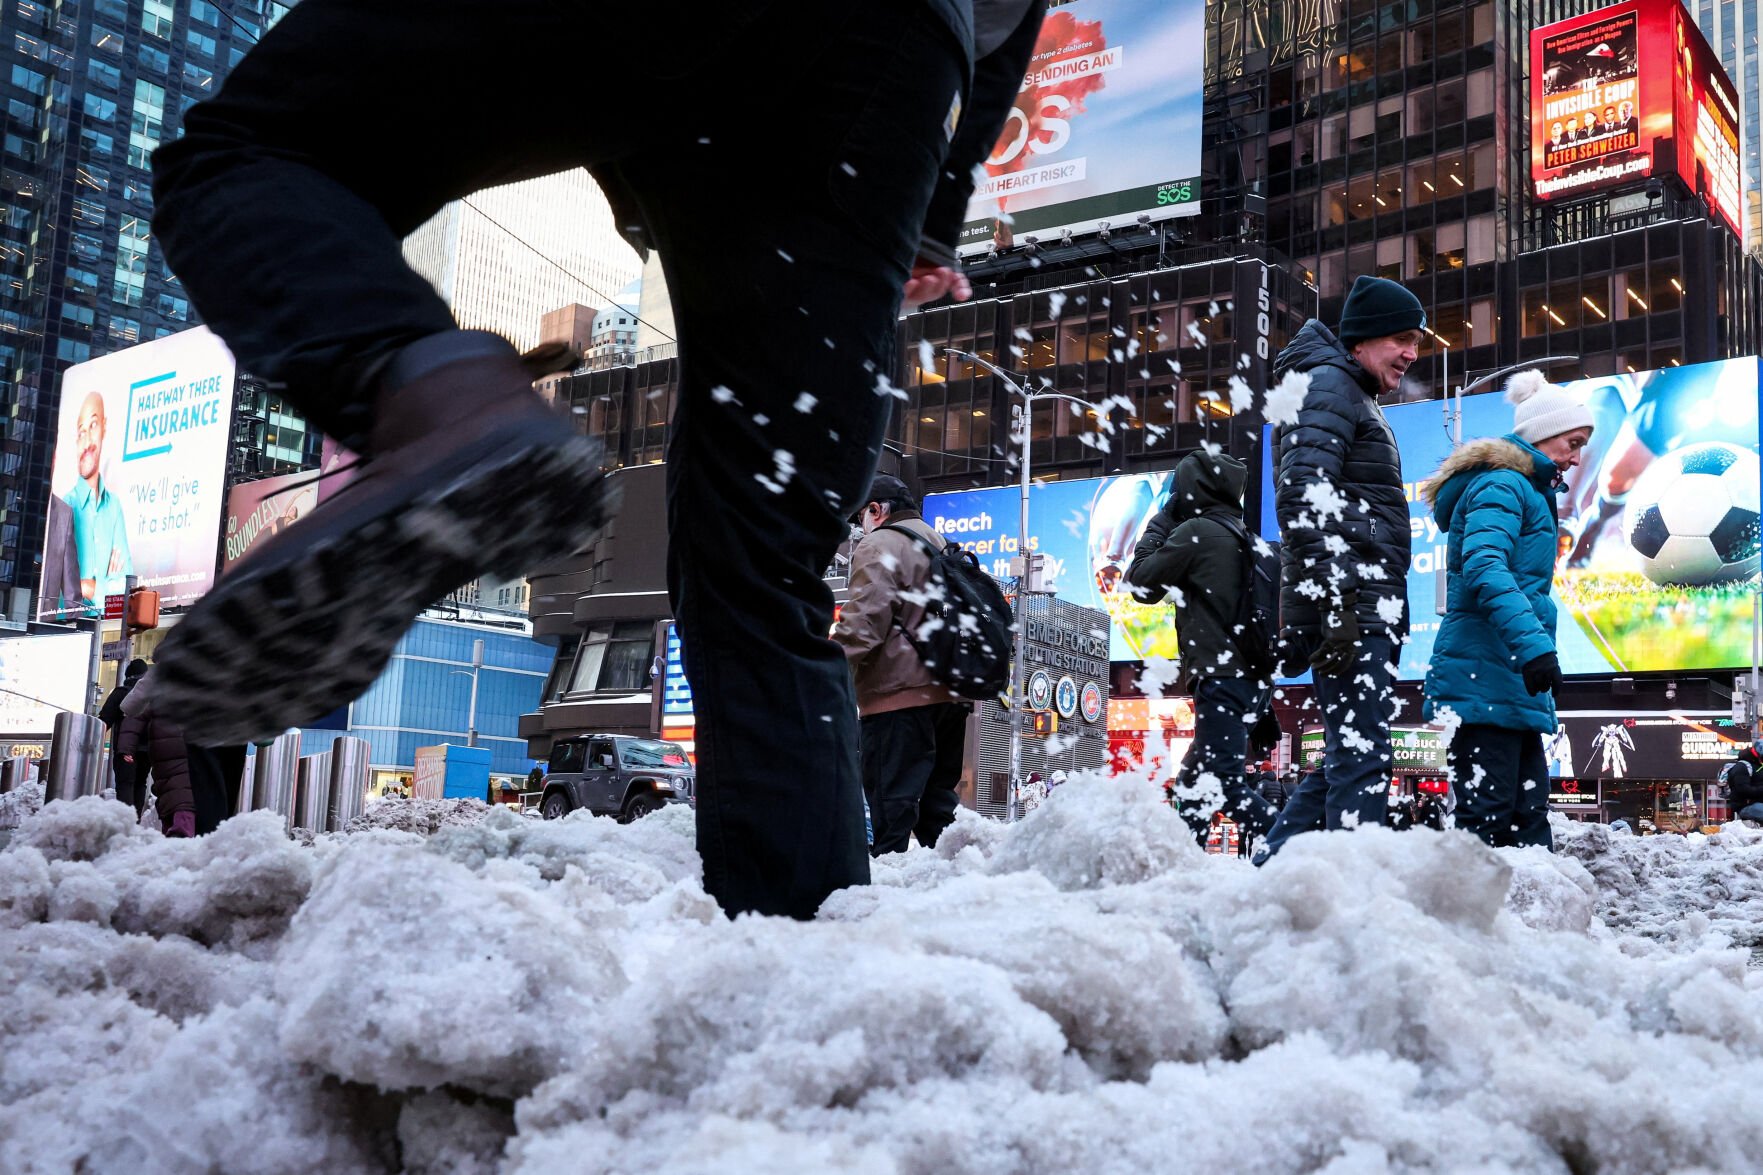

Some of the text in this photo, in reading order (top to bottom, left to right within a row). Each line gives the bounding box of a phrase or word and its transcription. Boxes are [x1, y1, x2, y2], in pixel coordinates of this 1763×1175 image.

[1040, 51, 1056, 60] type
[1063, 41, 1093, 54] diabetes
[1024, 53, 1114, 86] SENDING AN
[1582, 76, 1598, 93] THE
[1546, 80, 1636, 120] INVISIBLE COUP
[984, 94, 1070, 165] OS
[1547, 132, 1636, 168] PETER SCHWEIZER
[996, 172, 1038, 191] HEART
[1040, 164, 1076, 182] RISK?
[1157, 183, 1179, 191] DETECT
[1535, 157, 1650, 195] TheInvisibleCoup.com
[1157, 186, 1191, 205] SOS
[971, 225, 990, 237] test.
[1256, 265, 1270, 360] 1500
[138, 375, 222, 413] HALFWAY THERE
[135, 399, 220, 442] INSURANCE
[172, 475, 199, 506] give
[139, 513, 146, 536] it
[149, 518, 157, 533] a
[934, 512, 992, 534] Reach
[999, 534, 1039, 553] fas
[1063, 629, 1108, 660] FORCES
[1063, 654, 1103, 678] STATION
[11, 744, 44, 759] GIFTS
[1394, 750, 1437, 761] COFFEE
[1681, 742, 1732, 754] GUNDAM
